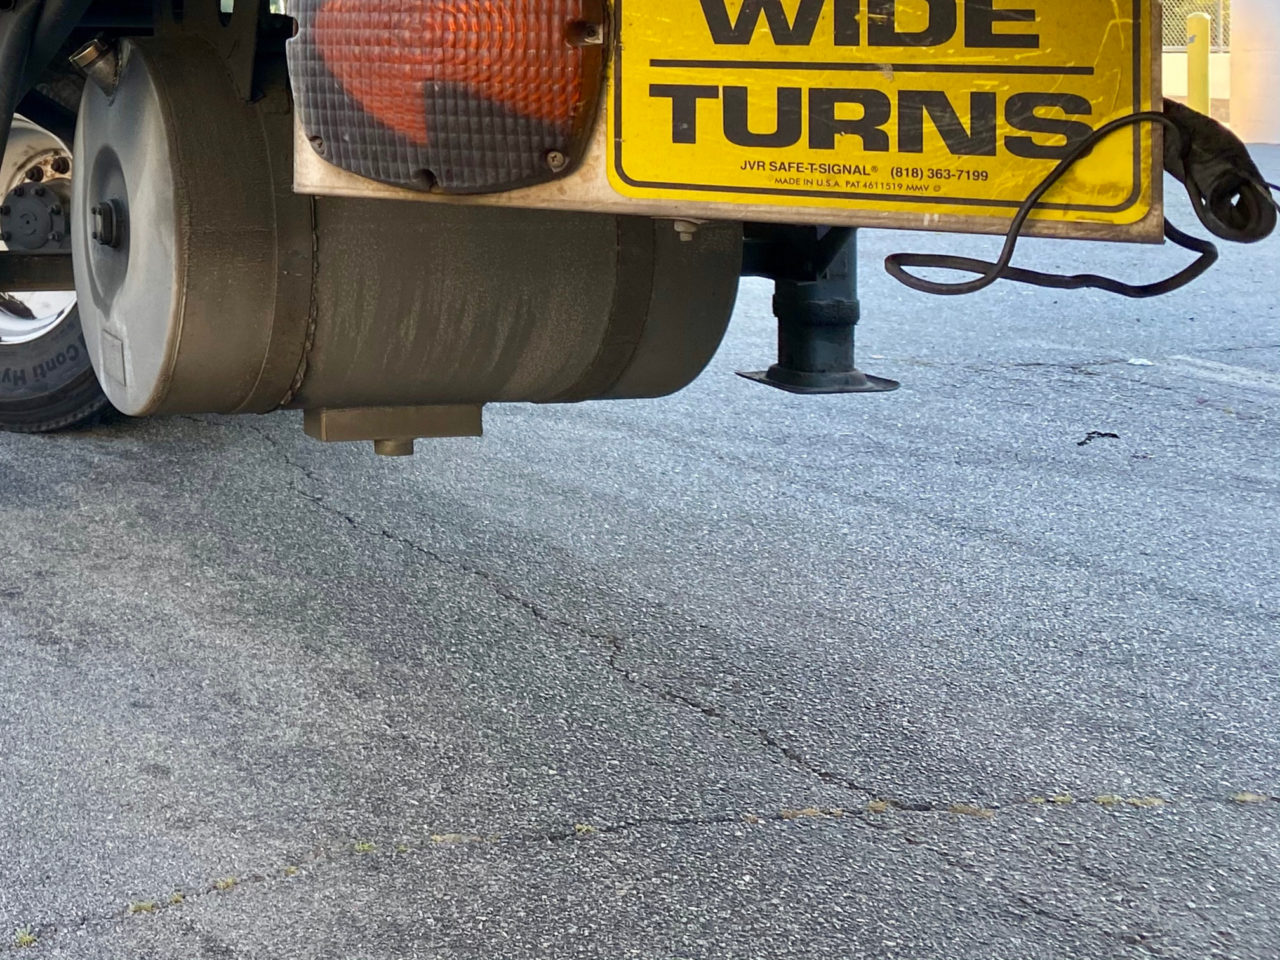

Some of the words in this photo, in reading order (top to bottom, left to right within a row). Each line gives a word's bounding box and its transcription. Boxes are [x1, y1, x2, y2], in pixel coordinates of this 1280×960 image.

[650, 84, 1095, 160] TURNS
[740, 160, 766, 171] JVR
[890, 166, 924, 180] (818)
[927, 168, 989, 182] 363-7199
[863, 181, 903, 190] 4611519
[32, 343, 80, 379] Conti
